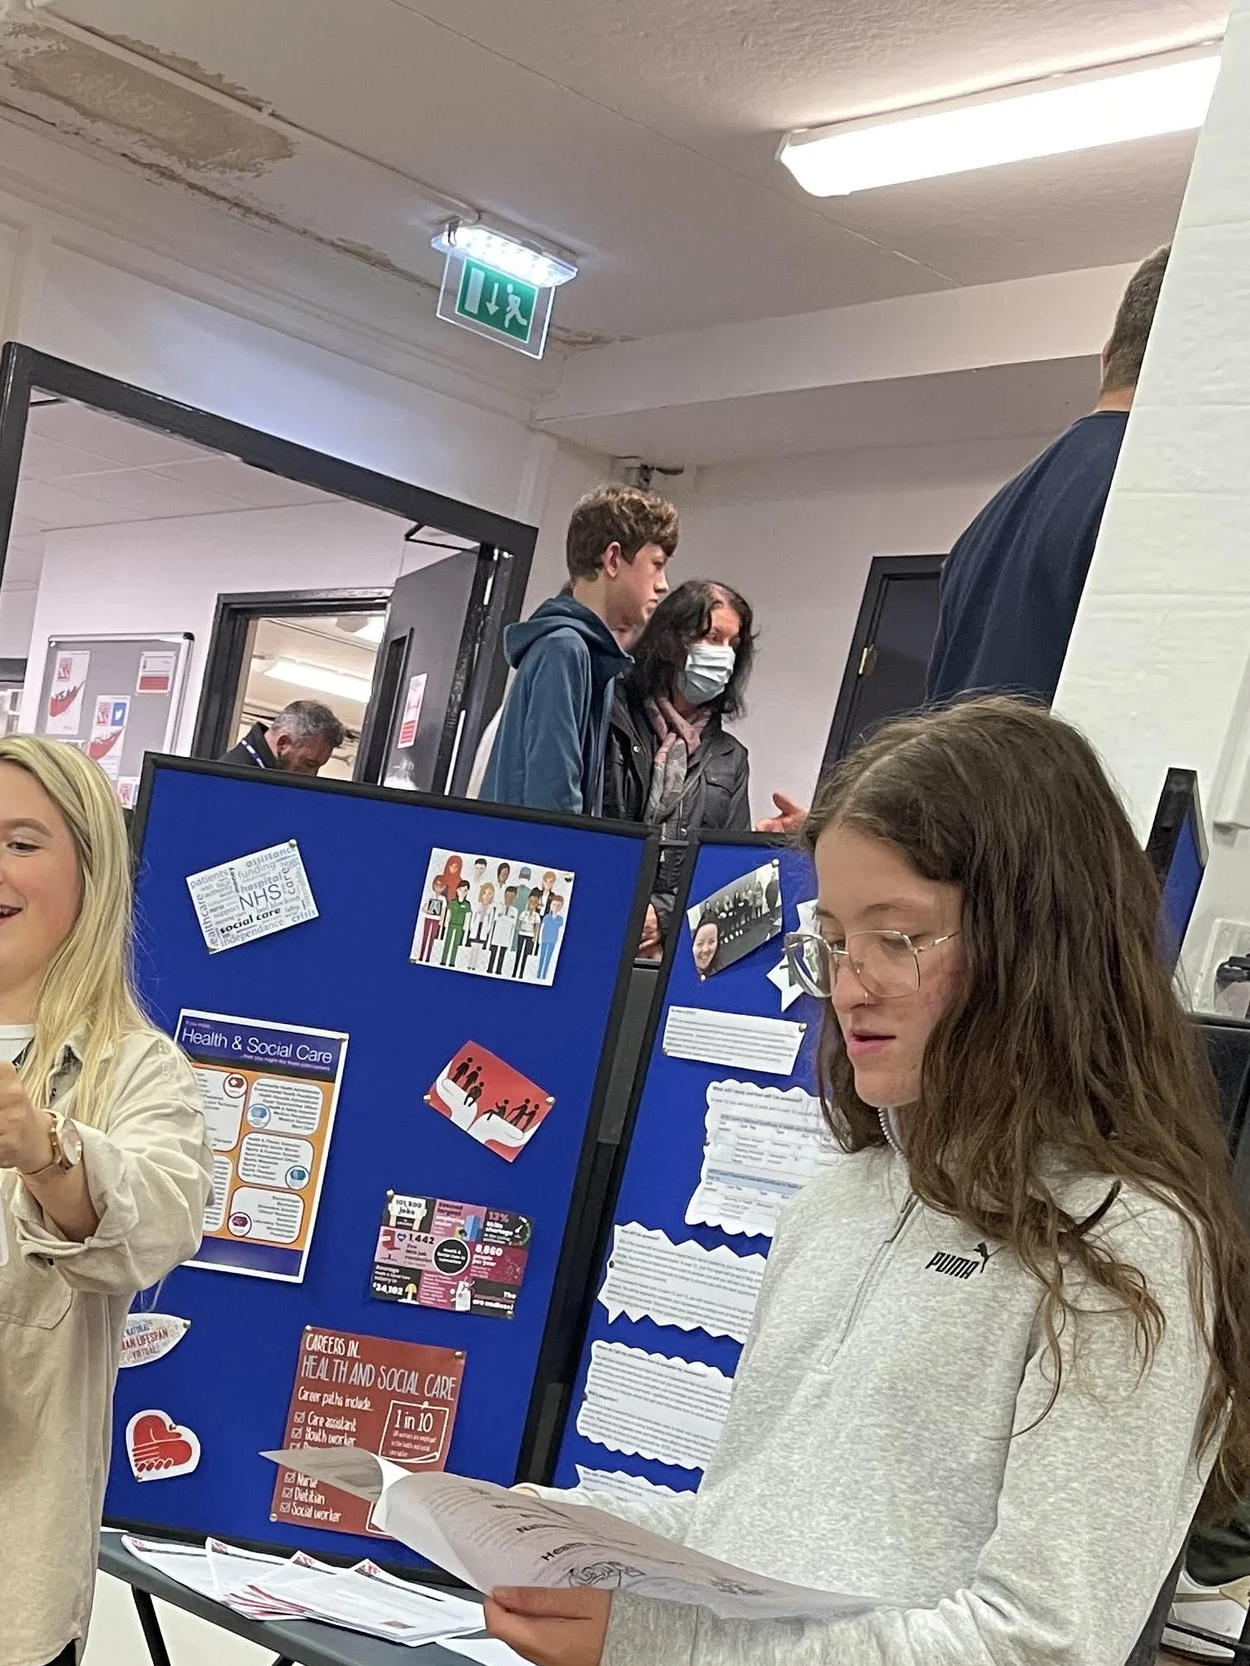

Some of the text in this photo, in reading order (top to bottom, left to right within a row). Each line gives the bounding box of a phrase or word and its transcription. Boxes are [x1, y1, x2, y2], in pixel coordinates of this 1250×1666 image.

[190, 869, 228, 889] patients
[240, 872, 283, 893] hospital
[282, 867, 296, 895] care
[239, 883, 282, 911] NHS
[196, 893, 219, 946] ealthcare
[219, 908, 281, 934] social care
[291, 909, 316, 923] crisis
[182, 1027, 333, 1064] Health & Social Care
[408, 1234, 435, 1245] 1,442
[925, 1251, 980, 1279] PUMA
[136, 1328, 169, 1347] LIFESPAN
[305, 1333, 346, 1356] CAREERS
[301, 1355, 457, 1401] HEALTH AND SOCIAL CARE
[298, 1386, 321, 1403] Career
[321, 1391, 344, 1408] paths
[307, 1411, 357, 1432] Care assistant
[395, 1409, 434, 1433] 1 in 10
[327, 1433, 357, 1448] worker
[291, 1503, 341, 1522] Social worker
